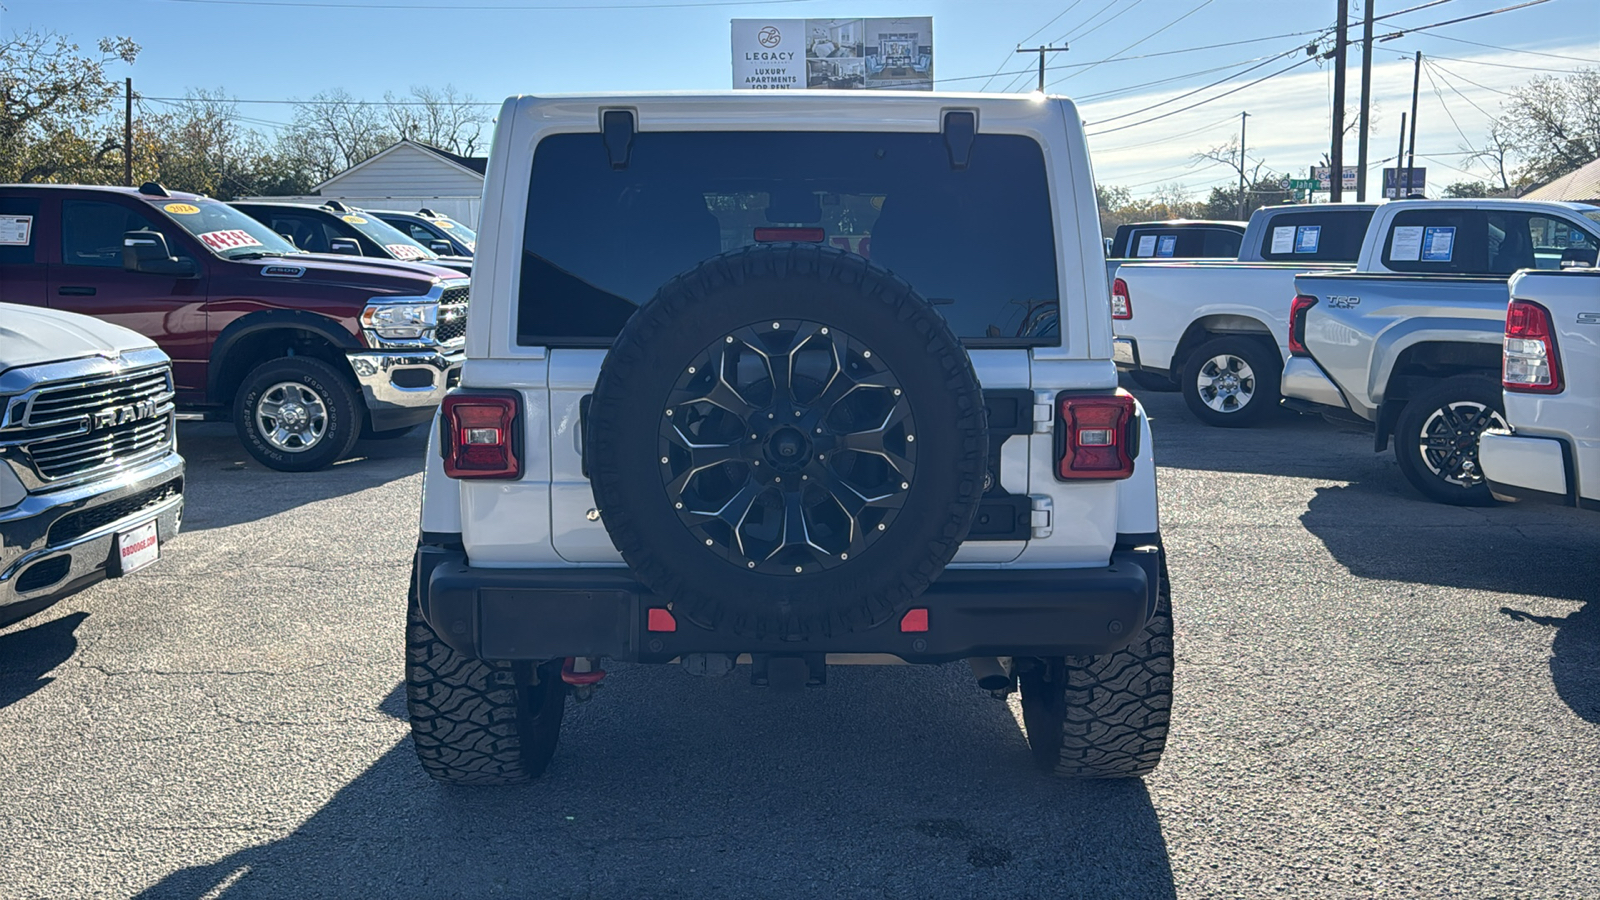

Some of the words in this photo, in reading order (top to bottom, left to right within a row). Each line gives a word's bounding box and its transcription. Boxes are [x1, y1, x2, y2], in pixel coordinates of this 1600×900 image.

[746, 52, 795, 60] LEGACY
[1295, 180, 1313, 189] Jahn
[169, 204, 194, 213] 2024
[201, 231, 257, 249] 44395
[94, 400, 155, 430] RAM
[121, 534, 156, 558] BBDODGE.COM
